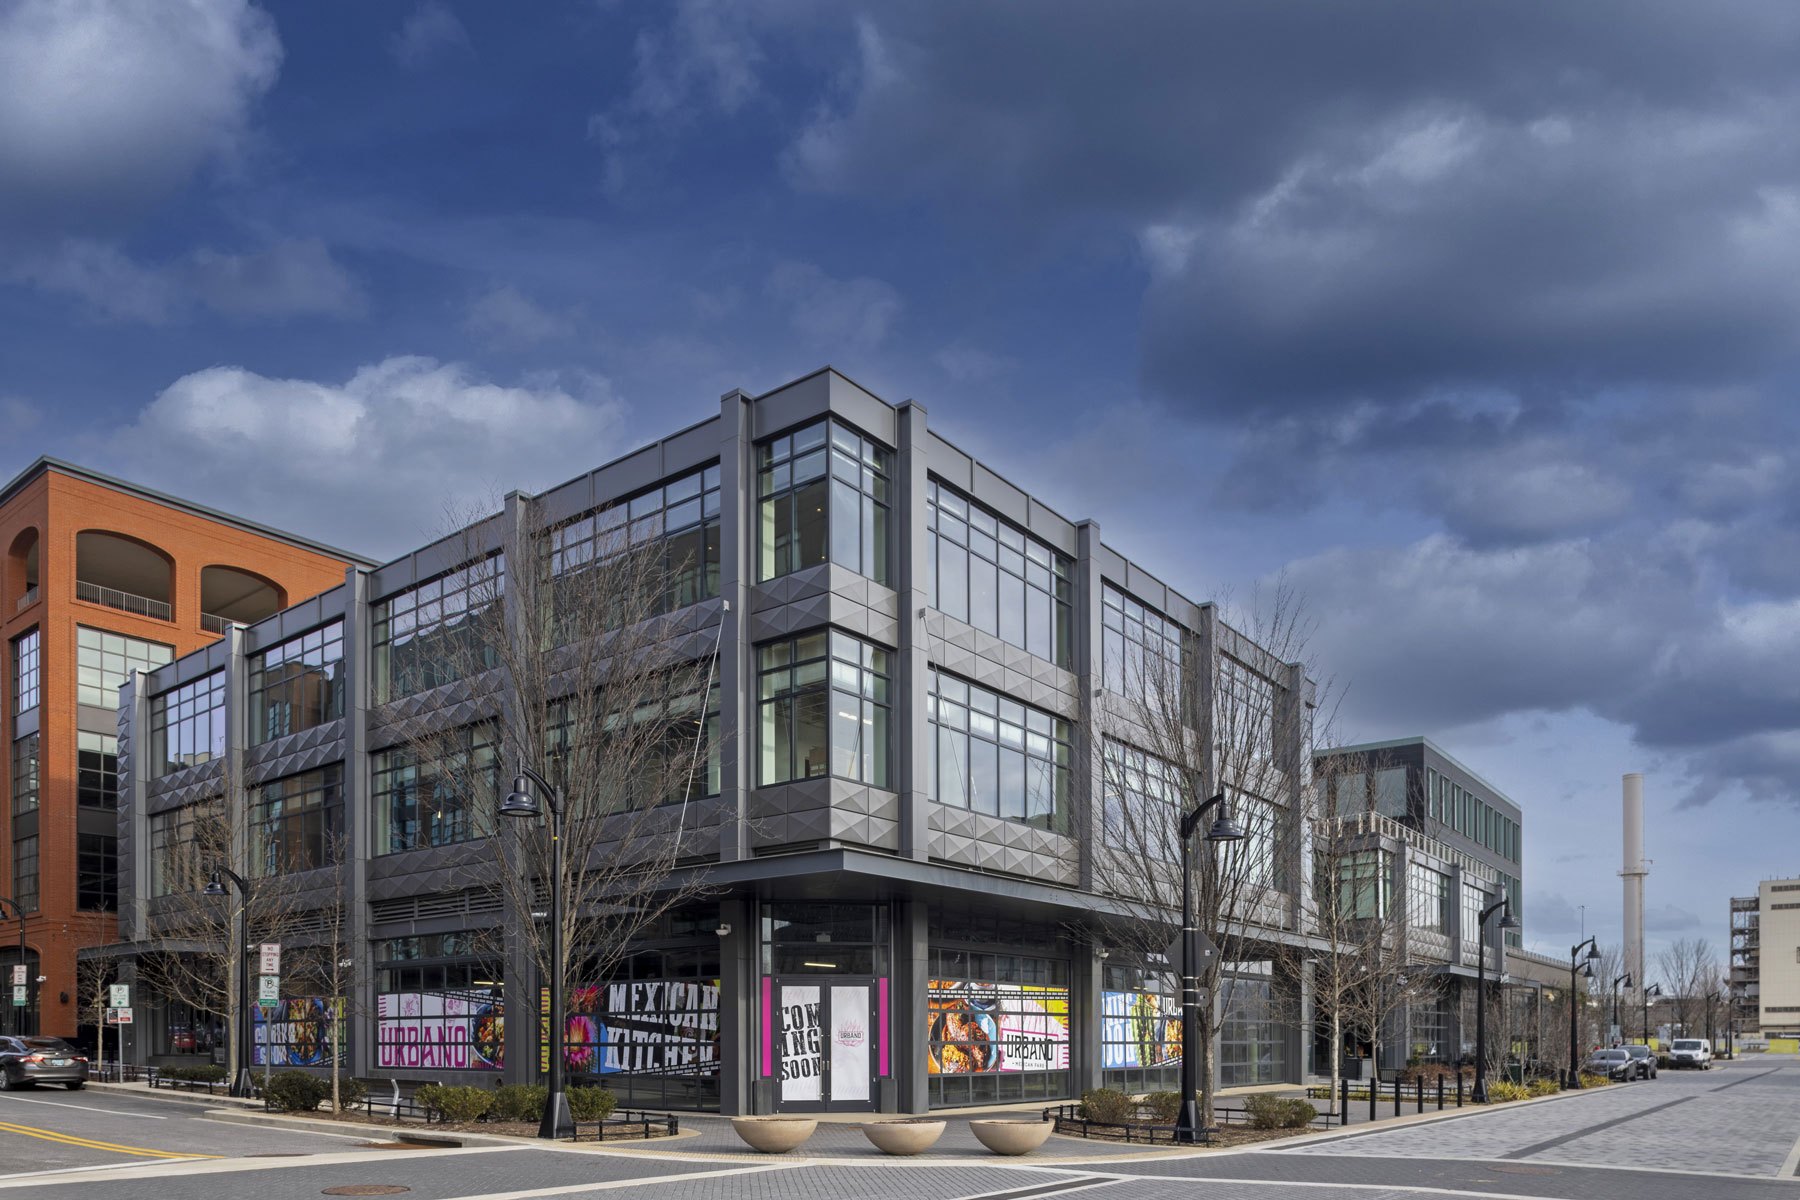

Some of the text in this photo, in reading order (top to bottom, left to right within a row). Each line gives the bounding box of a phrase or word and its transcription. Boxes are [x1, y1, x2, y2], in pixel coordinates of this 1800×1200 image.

[608, 982, 720, 1031] MEXICAN
[782, 1003, 820, 1032] COM
[260, 1045, 287, 1065] SON
[381, 1025, 467, 1068] URBANO
[605, 1026, 714, 1071] KITCHEN
[782, 1029, 820, 1057] ING
[1007, 1034, 1053, 1061] URBANO
[782, 1057, 820, 1081] SOON
